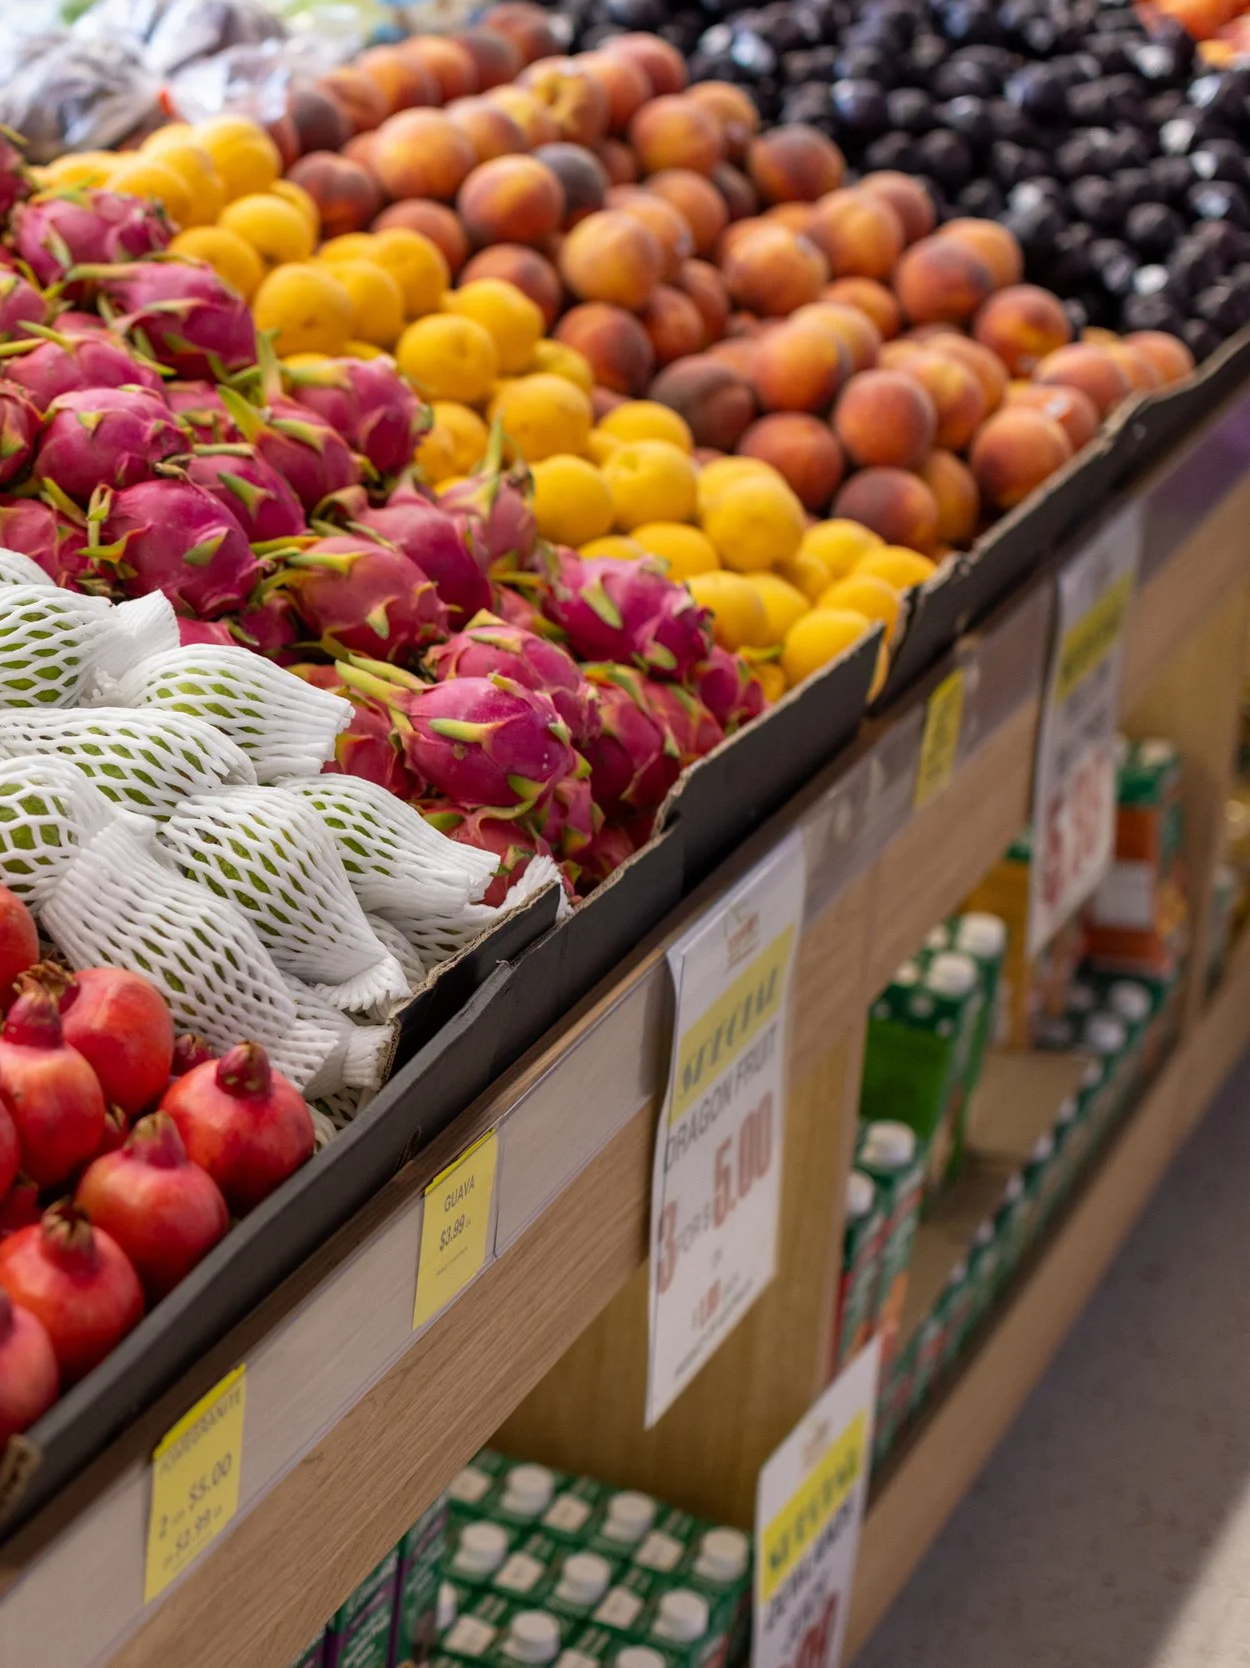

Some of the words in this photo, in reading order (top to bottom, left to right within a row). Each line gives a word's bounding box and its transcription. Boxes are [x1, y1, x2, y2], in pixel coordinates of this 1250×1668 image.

[664, 1072, 734, 1174] DRAGON
[735, 1020, 778, 1095] FRUIT
[439, 1214, 465, 1252] $3.99
[444, 1175, 475, 1213] GUAVA
[657, 1200, 678, 1295] 3
[158, 1513, 169, 1540] 2
[188, 1452, 233, 1511] $5.00
